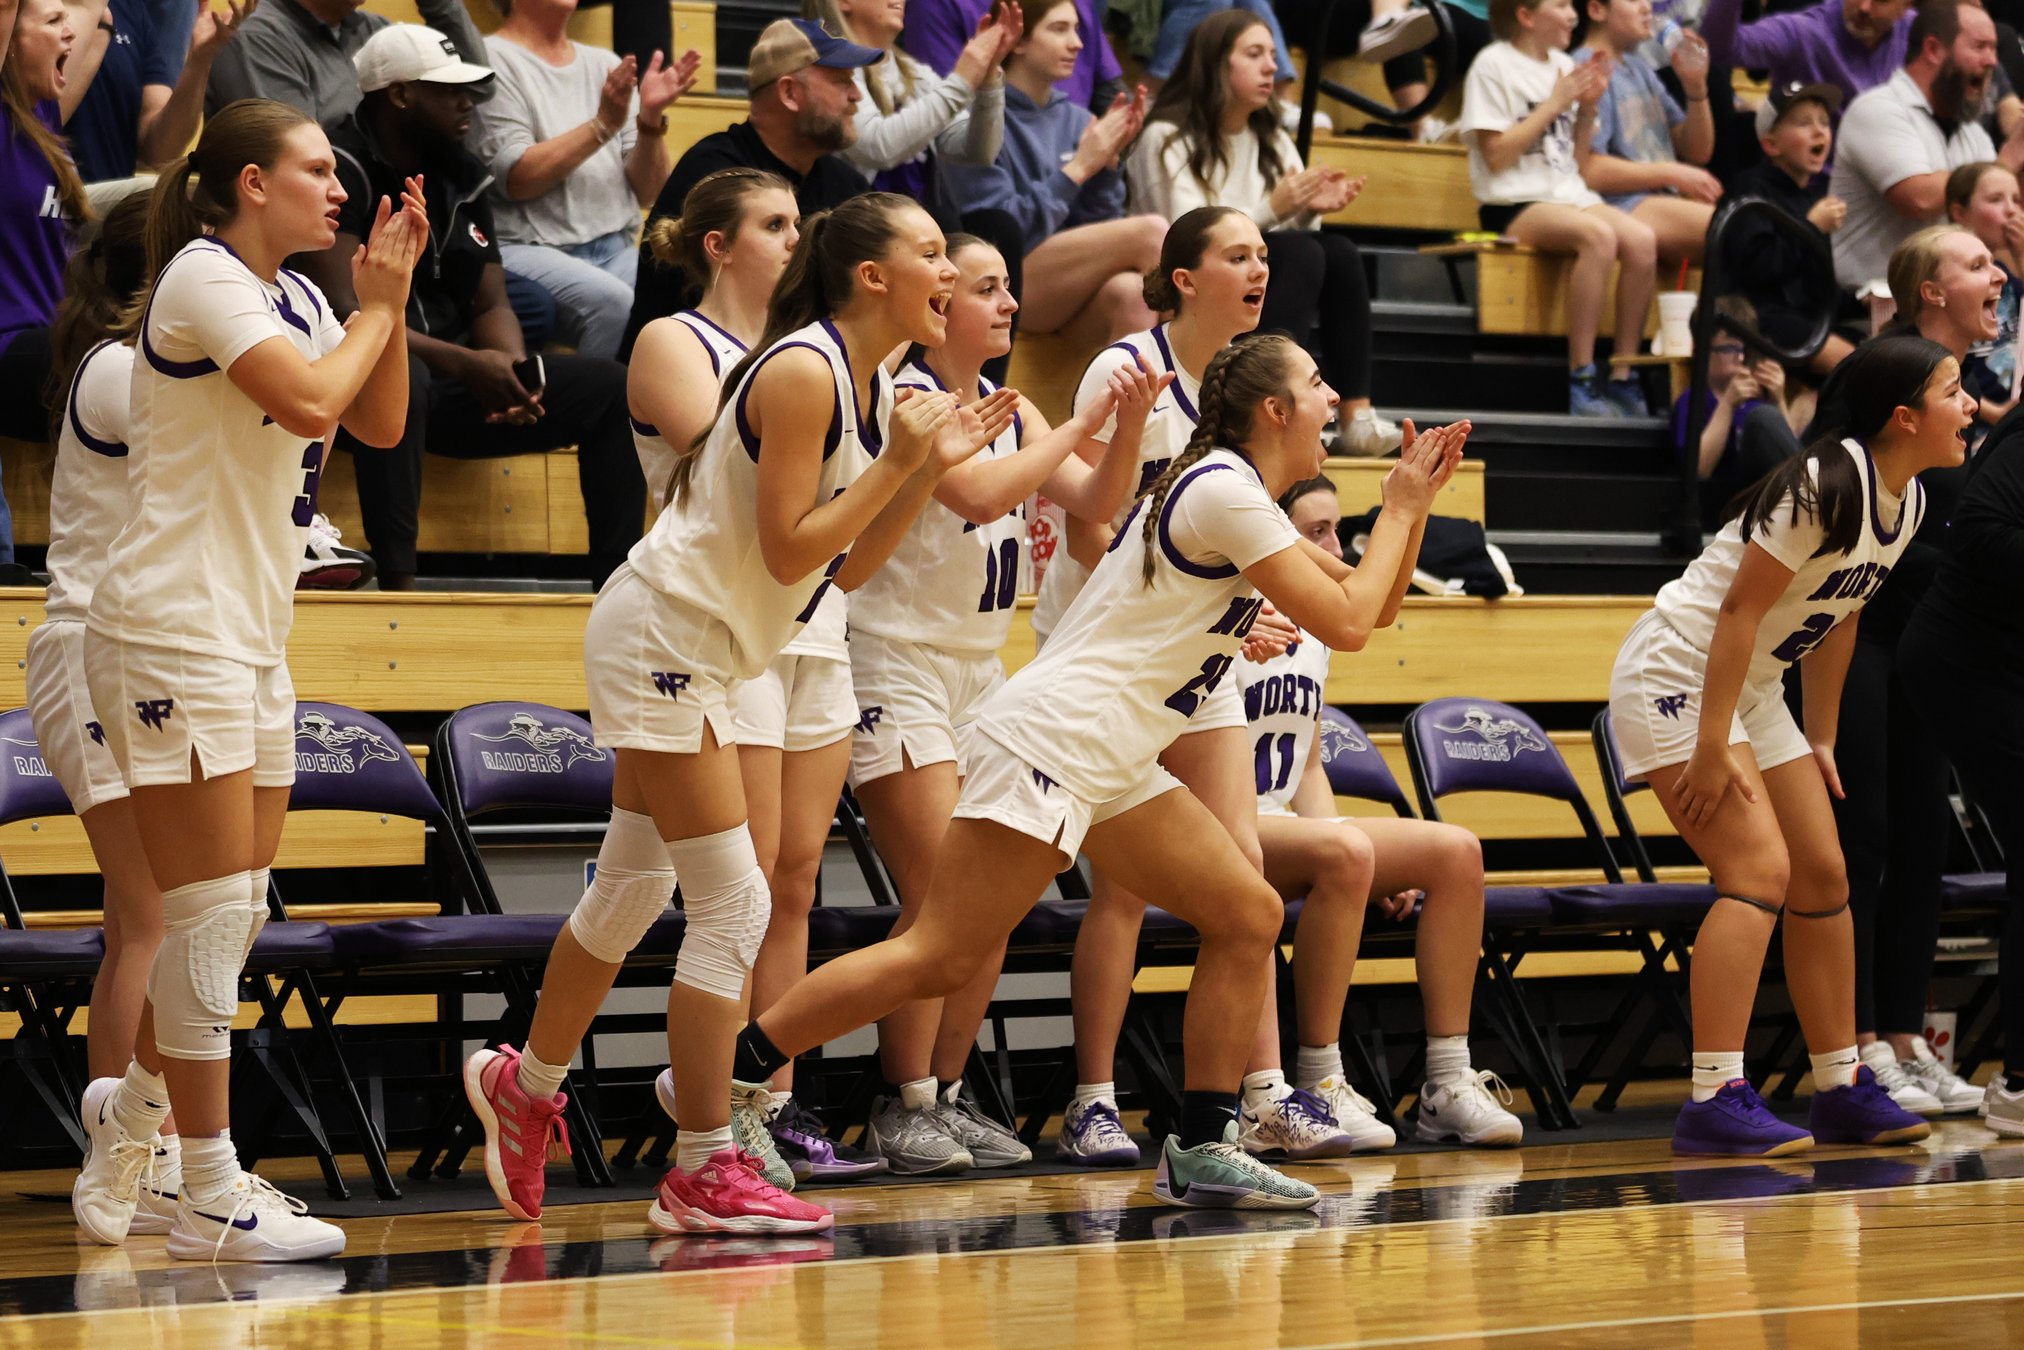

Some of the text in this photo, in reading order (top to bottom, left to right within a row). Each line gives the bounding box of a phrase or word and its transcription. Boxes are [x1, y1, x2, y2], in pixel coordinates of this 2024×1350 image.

[1031, 536, 1058, 562] CO
[978, 537, 1019, 613] 10
[1806, 561, 1890, 601] NORT
[1770, 612, 1836, 662] 2
[295, 752, 355, 773] IDERS
[481, 751, 563, 773] RAIDERS
[1254, 732, 1296, 795] 11
[1443, 740, 1511, 762] RAIDERS
